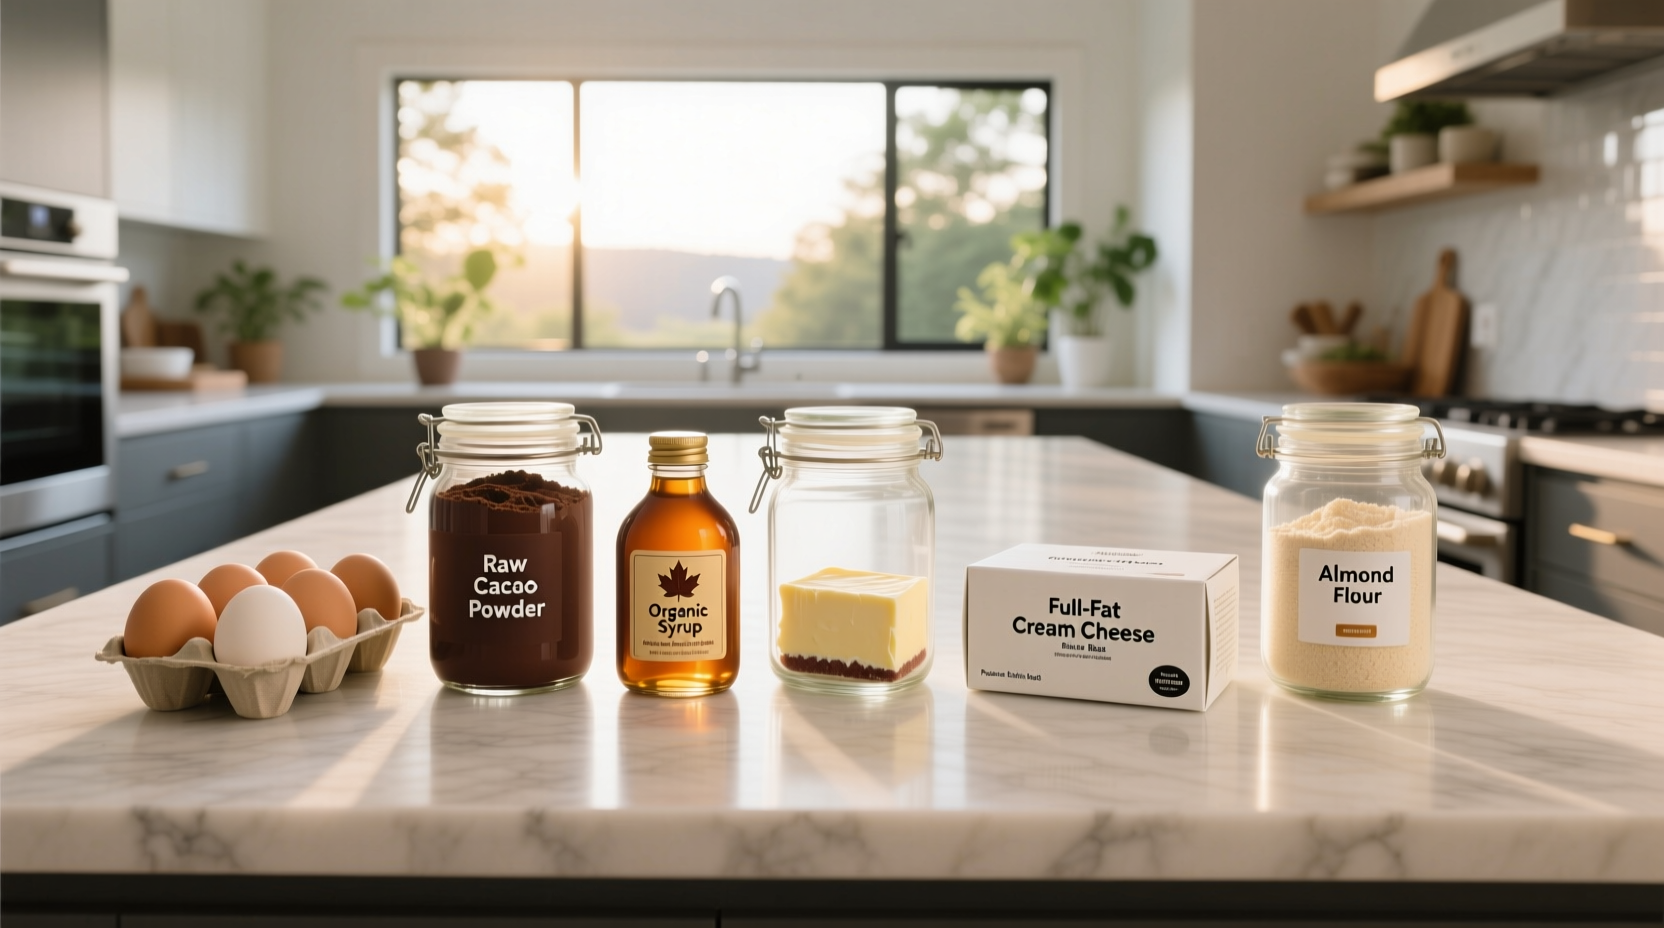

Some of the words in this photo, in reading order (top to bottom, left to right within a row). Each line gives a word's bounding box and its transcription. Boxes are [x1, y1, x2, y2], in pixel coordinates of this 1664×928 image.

[483, 554, 528, 573] Raw
[1318, 564, 1394, 583] Almond
[473, 576, 538, 595] Cacao
[1333, 586, 1382, 604] Flour
[469, 599, 546, 619] Powder
[648, 603, 708, 622] Organic
[1049, 597, 1121, 619] Full-Fat
[657, 619, 703, 639] Syrup
[1012, 616, 1076, 638] Cream
[1080, 621, 1155, 643] Cheese
